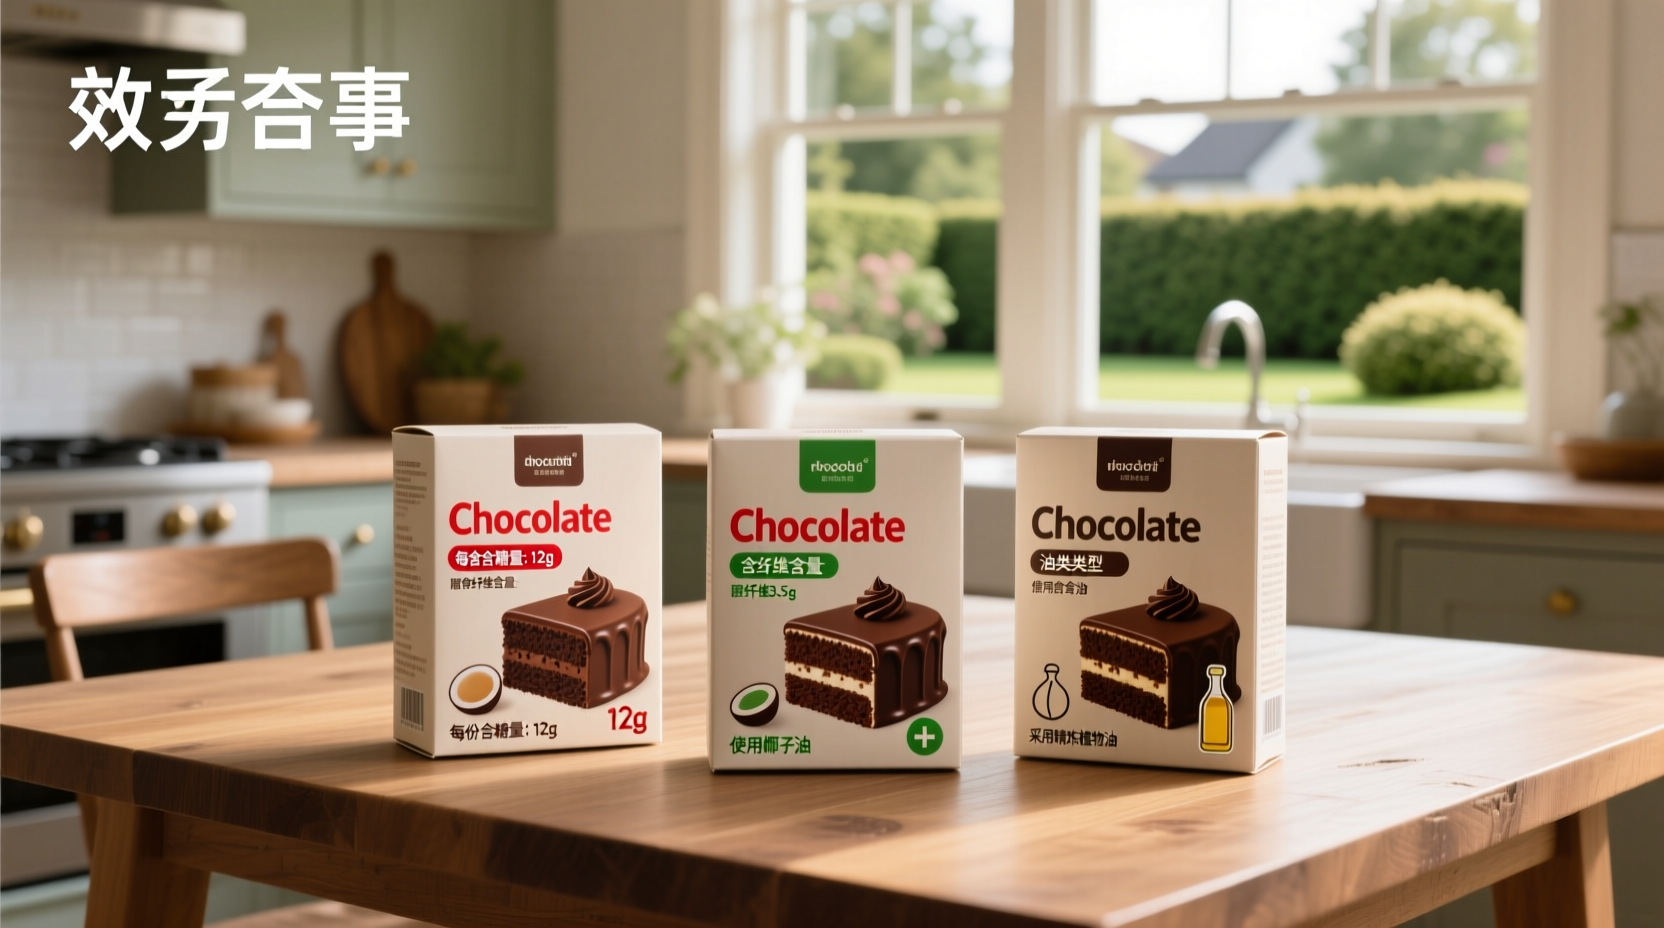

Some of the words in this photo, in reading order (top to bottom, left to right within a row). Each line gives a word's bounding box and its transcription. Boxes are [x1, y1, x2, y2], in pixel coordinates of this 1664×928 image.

[449, 500, 612, 535] Chocolate
[730, 507, 906, 543] Chocolate
[1031, 505, 1202, 543] Chocolate
[533, 721, 558, 740] 12g
[607, 705, 648, 735] 12g
